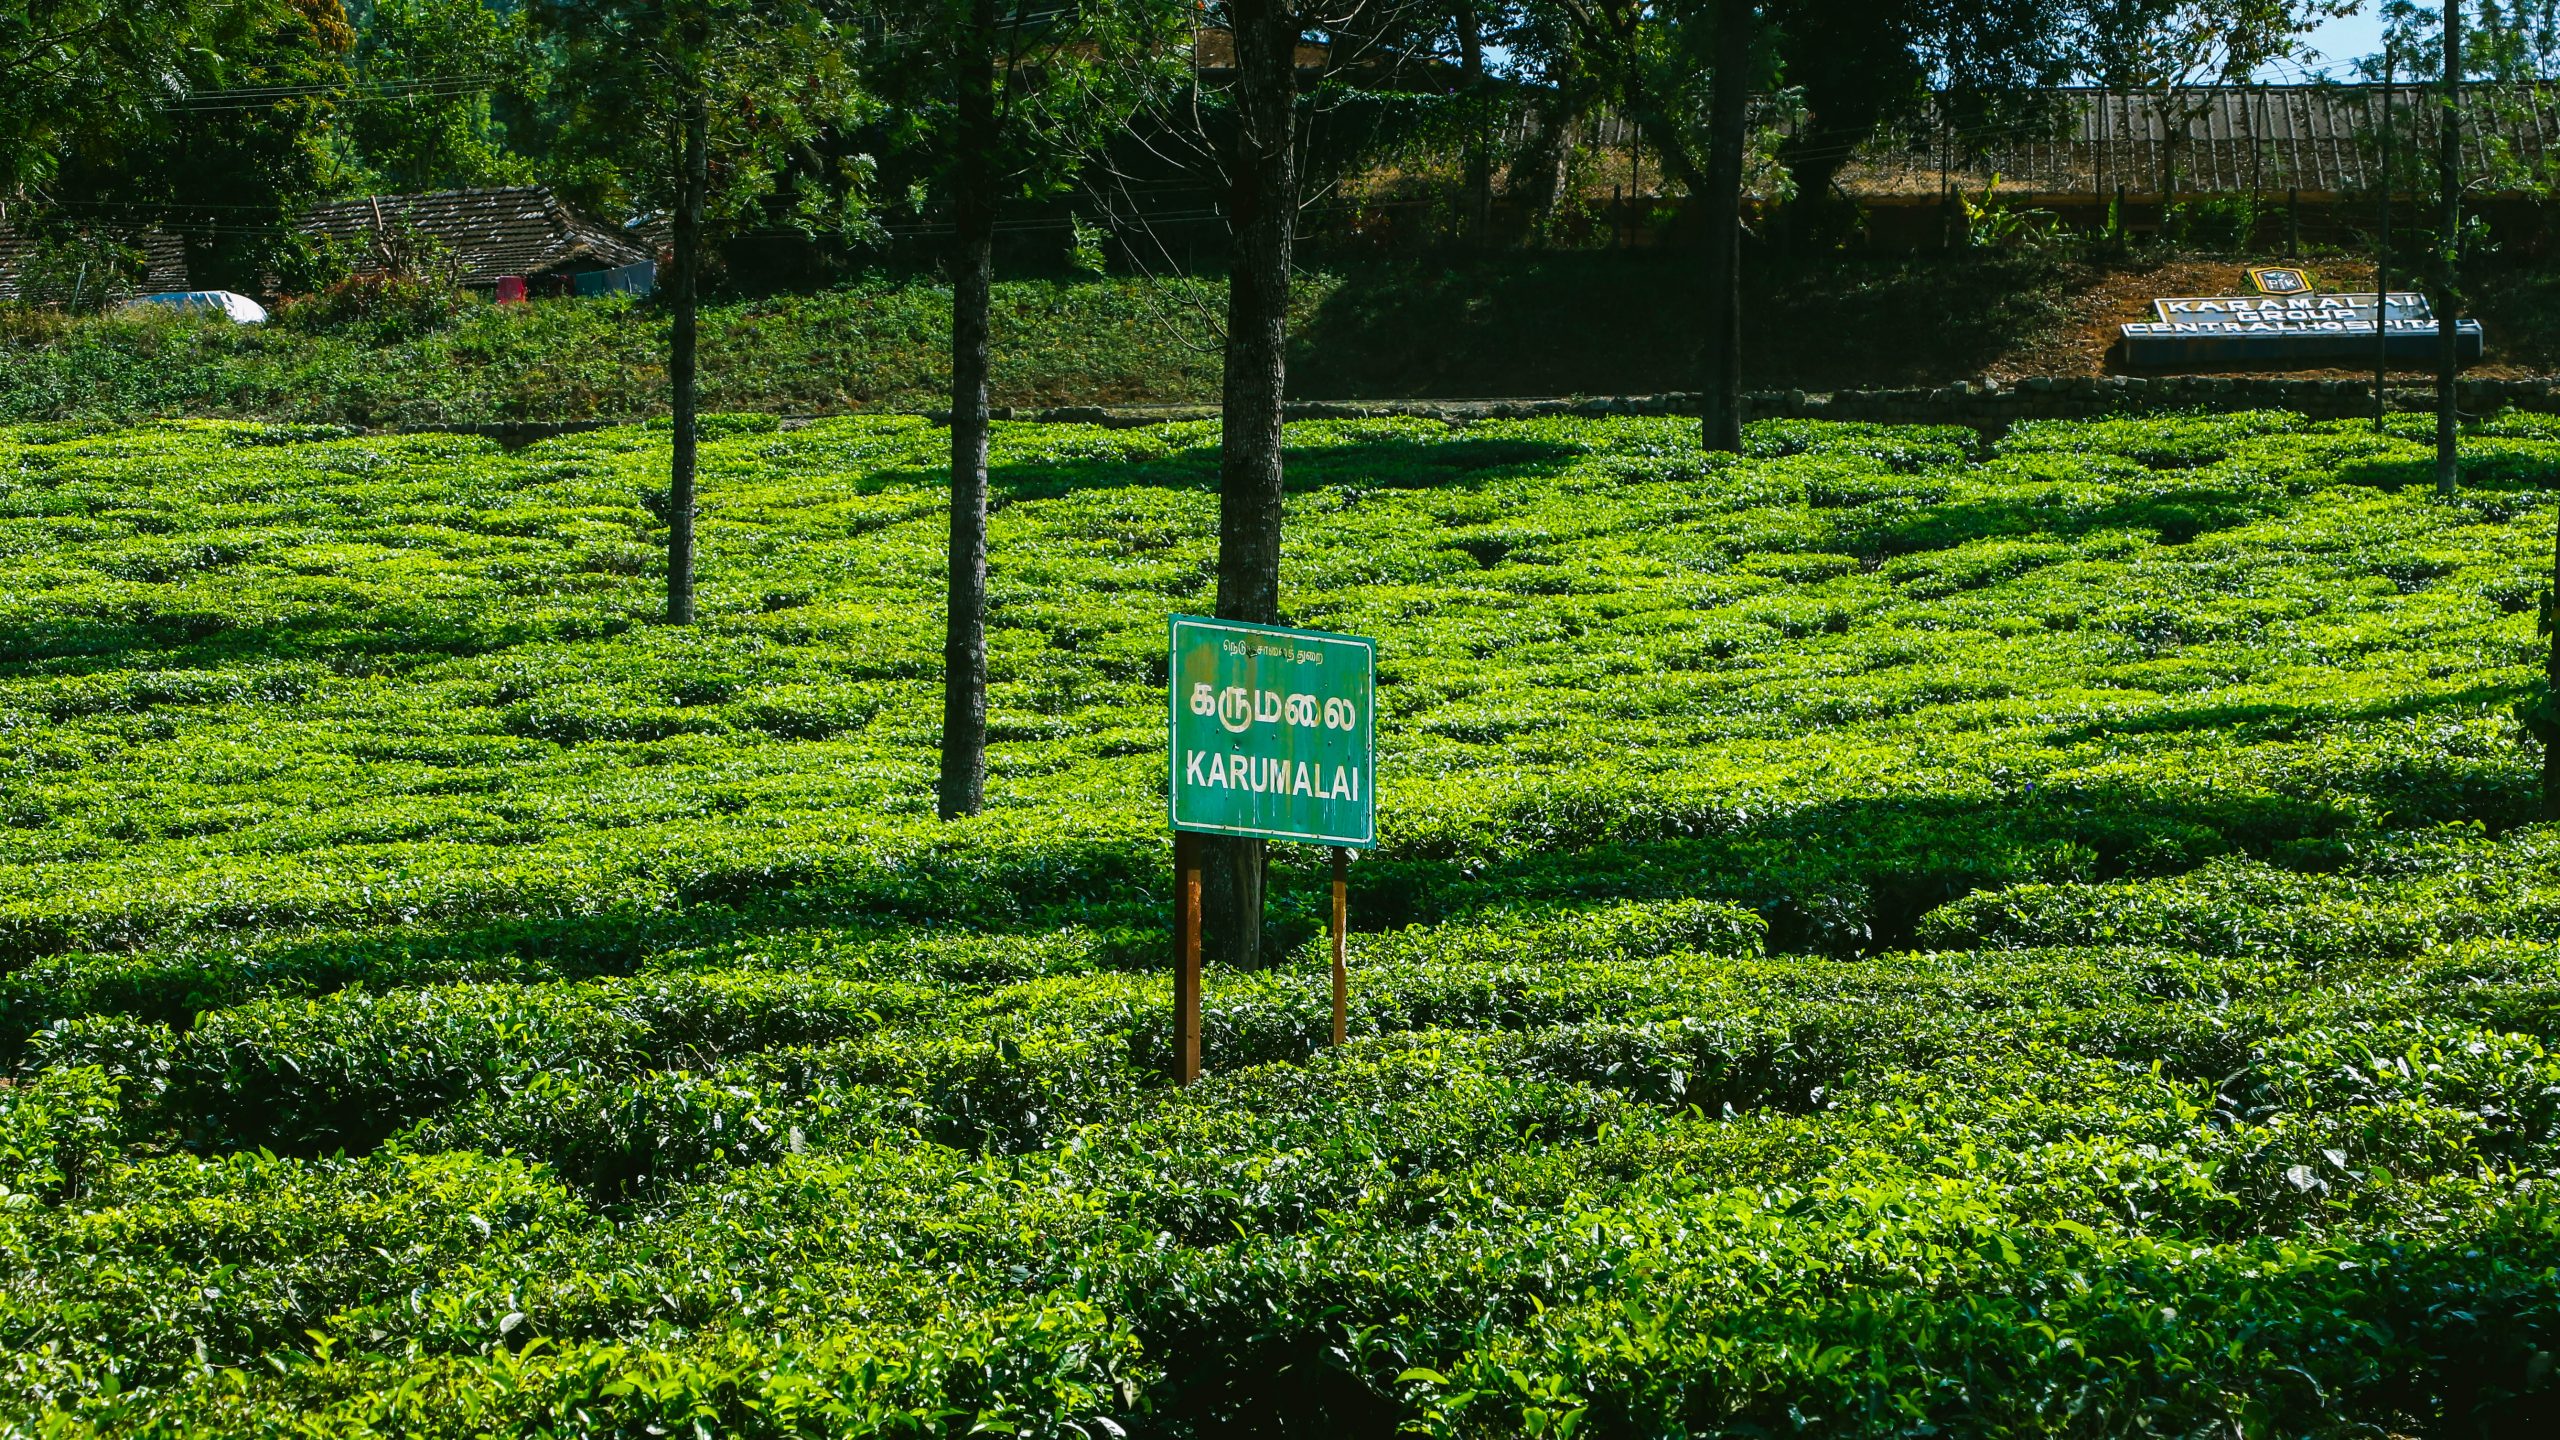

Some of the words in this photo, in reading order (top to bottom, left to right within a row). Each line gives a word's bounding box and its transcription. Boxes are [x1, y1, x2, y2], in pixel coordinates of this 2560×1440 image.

[2165, 295, 2416, 314] KARAMALAI
[2235, 308, 2357, 322] GROUP
[1189, 681, 1356, 734] கருமலை
[1186, 749, 1359, 802] KARUMALAI
